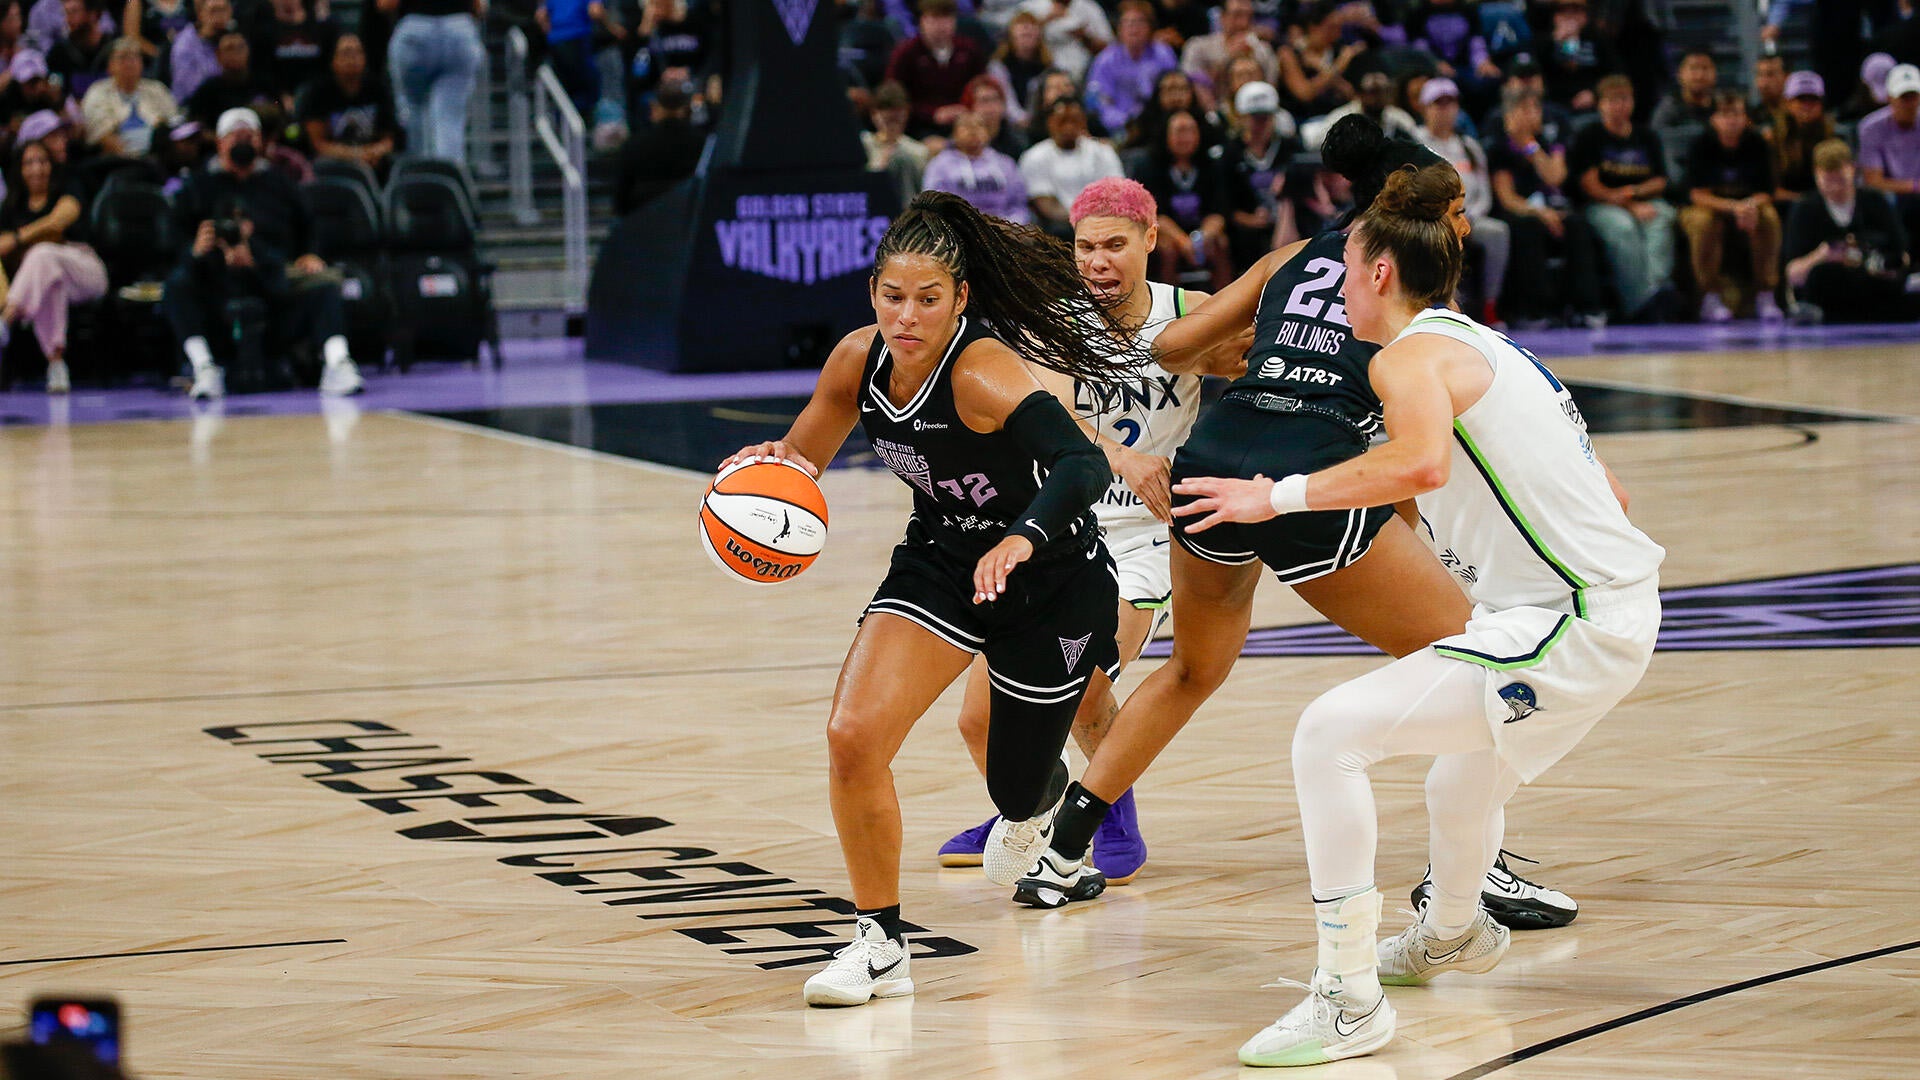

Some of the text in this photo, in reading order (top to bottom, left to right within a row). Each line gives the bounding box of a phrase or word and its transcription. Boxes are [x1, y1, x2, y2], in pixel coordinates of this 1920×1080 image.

[736, 192, 868, 218] GOLDEN STATE
[714, 216, 889, 285] VALKYRIES
[1274, 321, 1346, 355] BILLINGS
[1284, 366, 1343, 386] AT&T
[1073, 374, 1181, 414] LYNX
[921, 421, 949, 431] freedom
[875, 437, 916, 455] GOLDEN STATE
[725, 536, 802, 578] Wilson
[202, 720, 980, 970] CHASE CENTER
